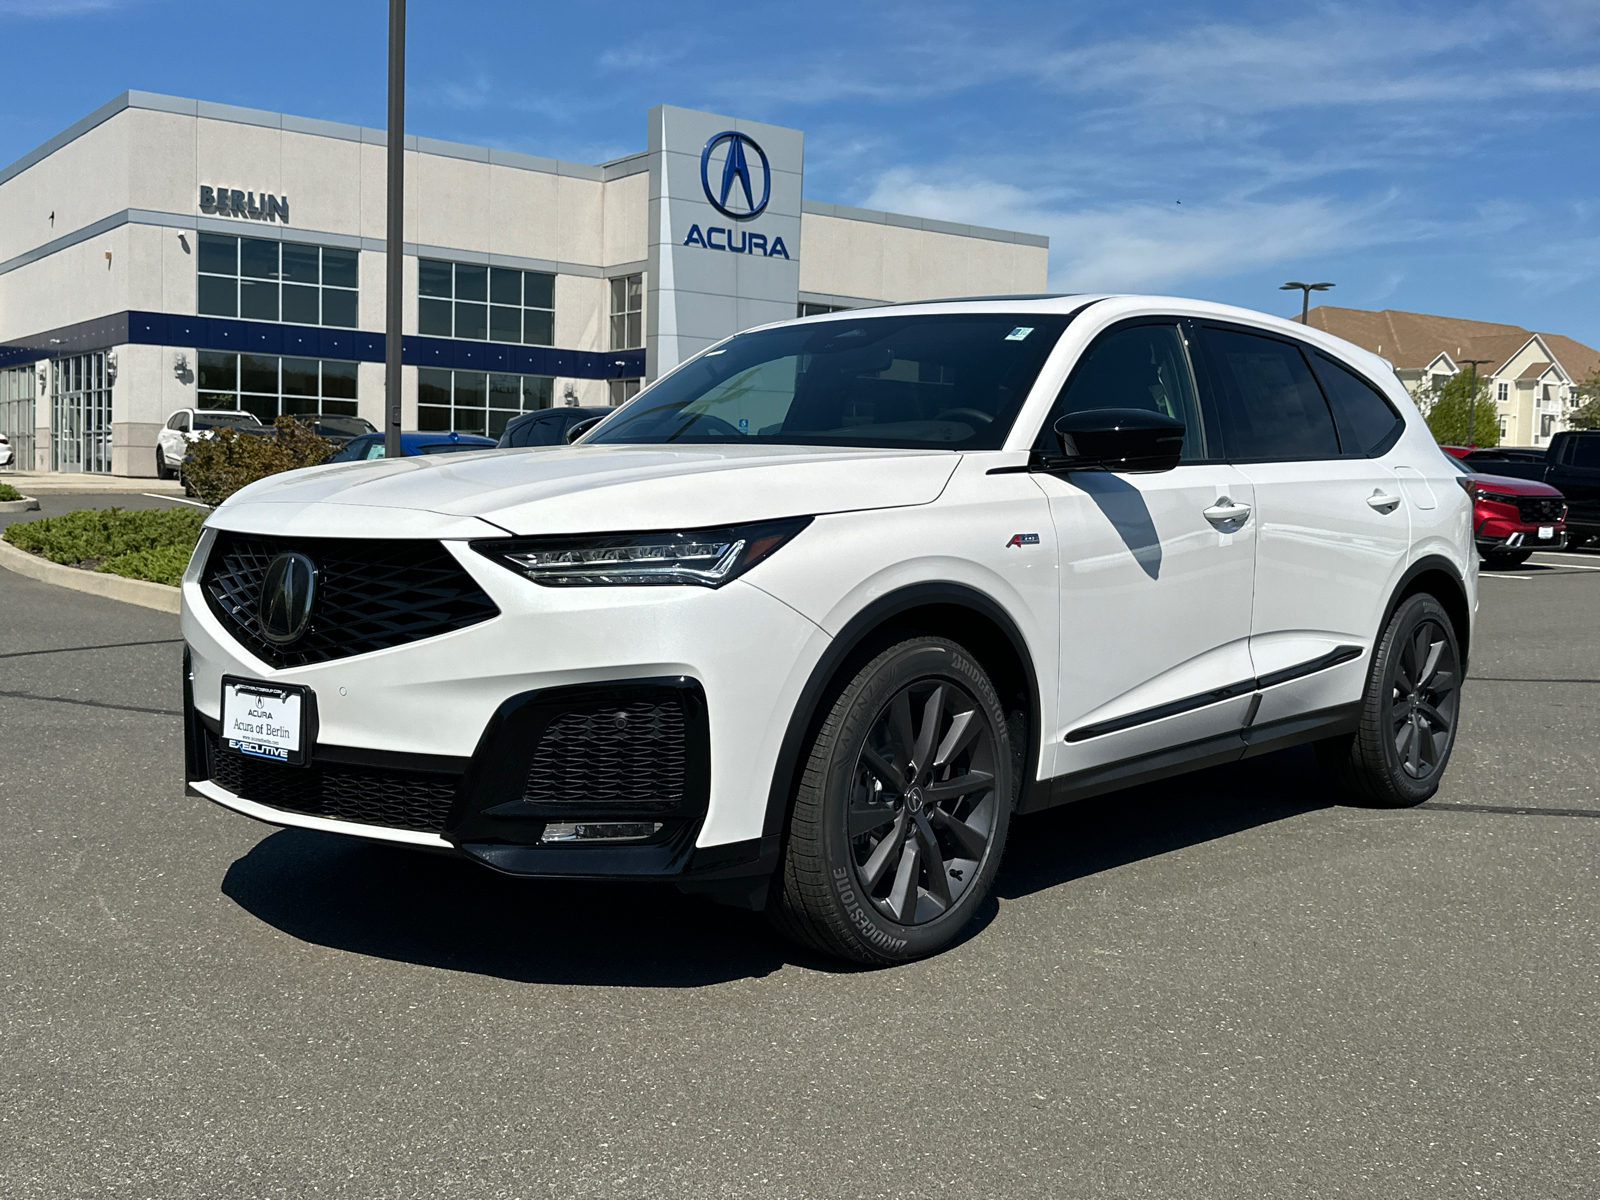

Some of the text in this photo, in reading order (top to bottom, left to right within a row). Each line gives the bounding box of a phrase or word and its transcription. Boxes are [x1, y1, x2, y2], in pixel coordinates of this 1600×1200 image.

[200, 185, 288, 219] BERLIN
[683, 223, 790, 260] ACURA
[248, 709, 273, 720] ACURA
[841, 675, 887, 749] ALENZA
[951, 652, 1008, 743] BRIDGESTONE
[233, 718, 290, 739] Acura of Berlin
[229, 740, 288, 758] EXECUTIVE
[833, 867, 907, 953] BRIDGESTONE
